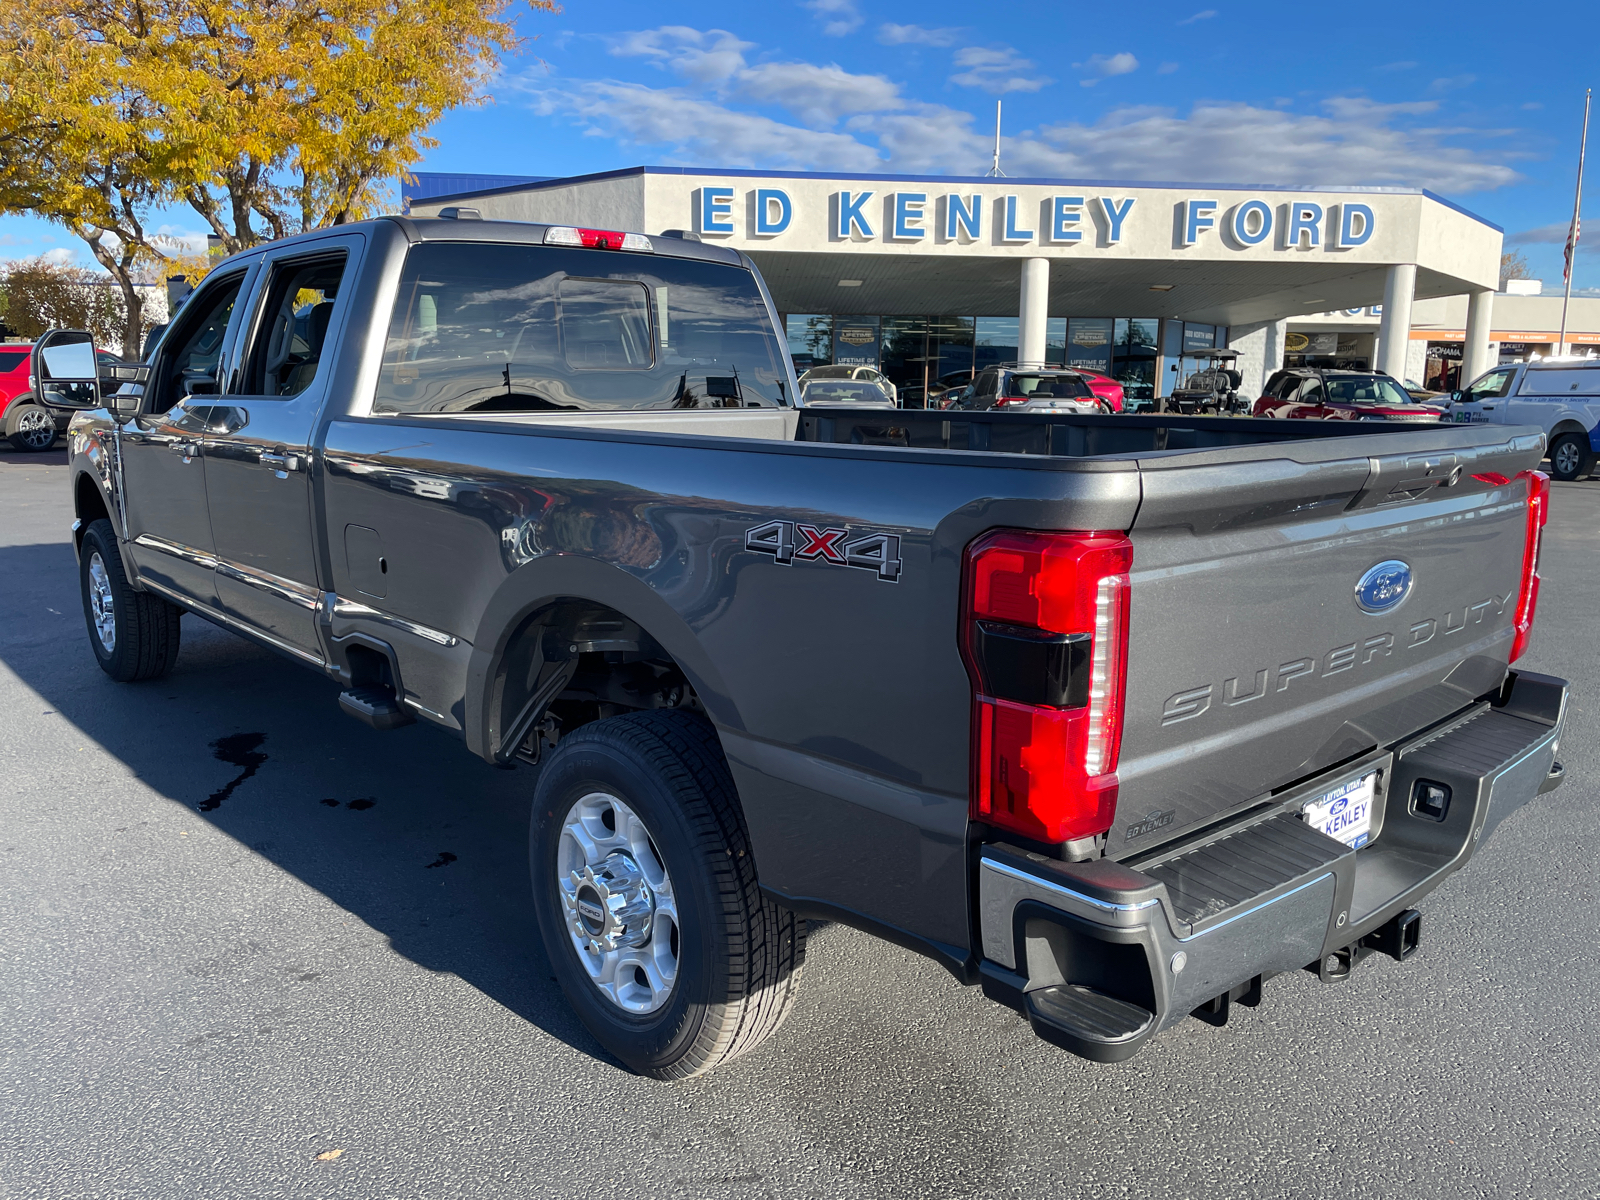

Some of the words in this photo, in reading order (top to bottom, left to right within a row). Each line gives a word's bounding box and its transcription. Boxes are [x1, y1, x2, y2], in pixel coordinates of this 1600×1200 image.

[700, 186, 794, 236] ED
[837, 190, 1137, 244] KENLEY
[1182, 197, 1376, 249] FORD
[1161, 630, 1395, 728] SUPER
[1407, 590, 1513, 650] DUTY
[1347, 779, 1361, 792] UTAH
[1126, 826, 1140, 839] ED
[1140, 812, 1175, 834] KENLEY
[1325, 802, 1368, 835] KENLEY
[580, 905, 601, 918] FORD
